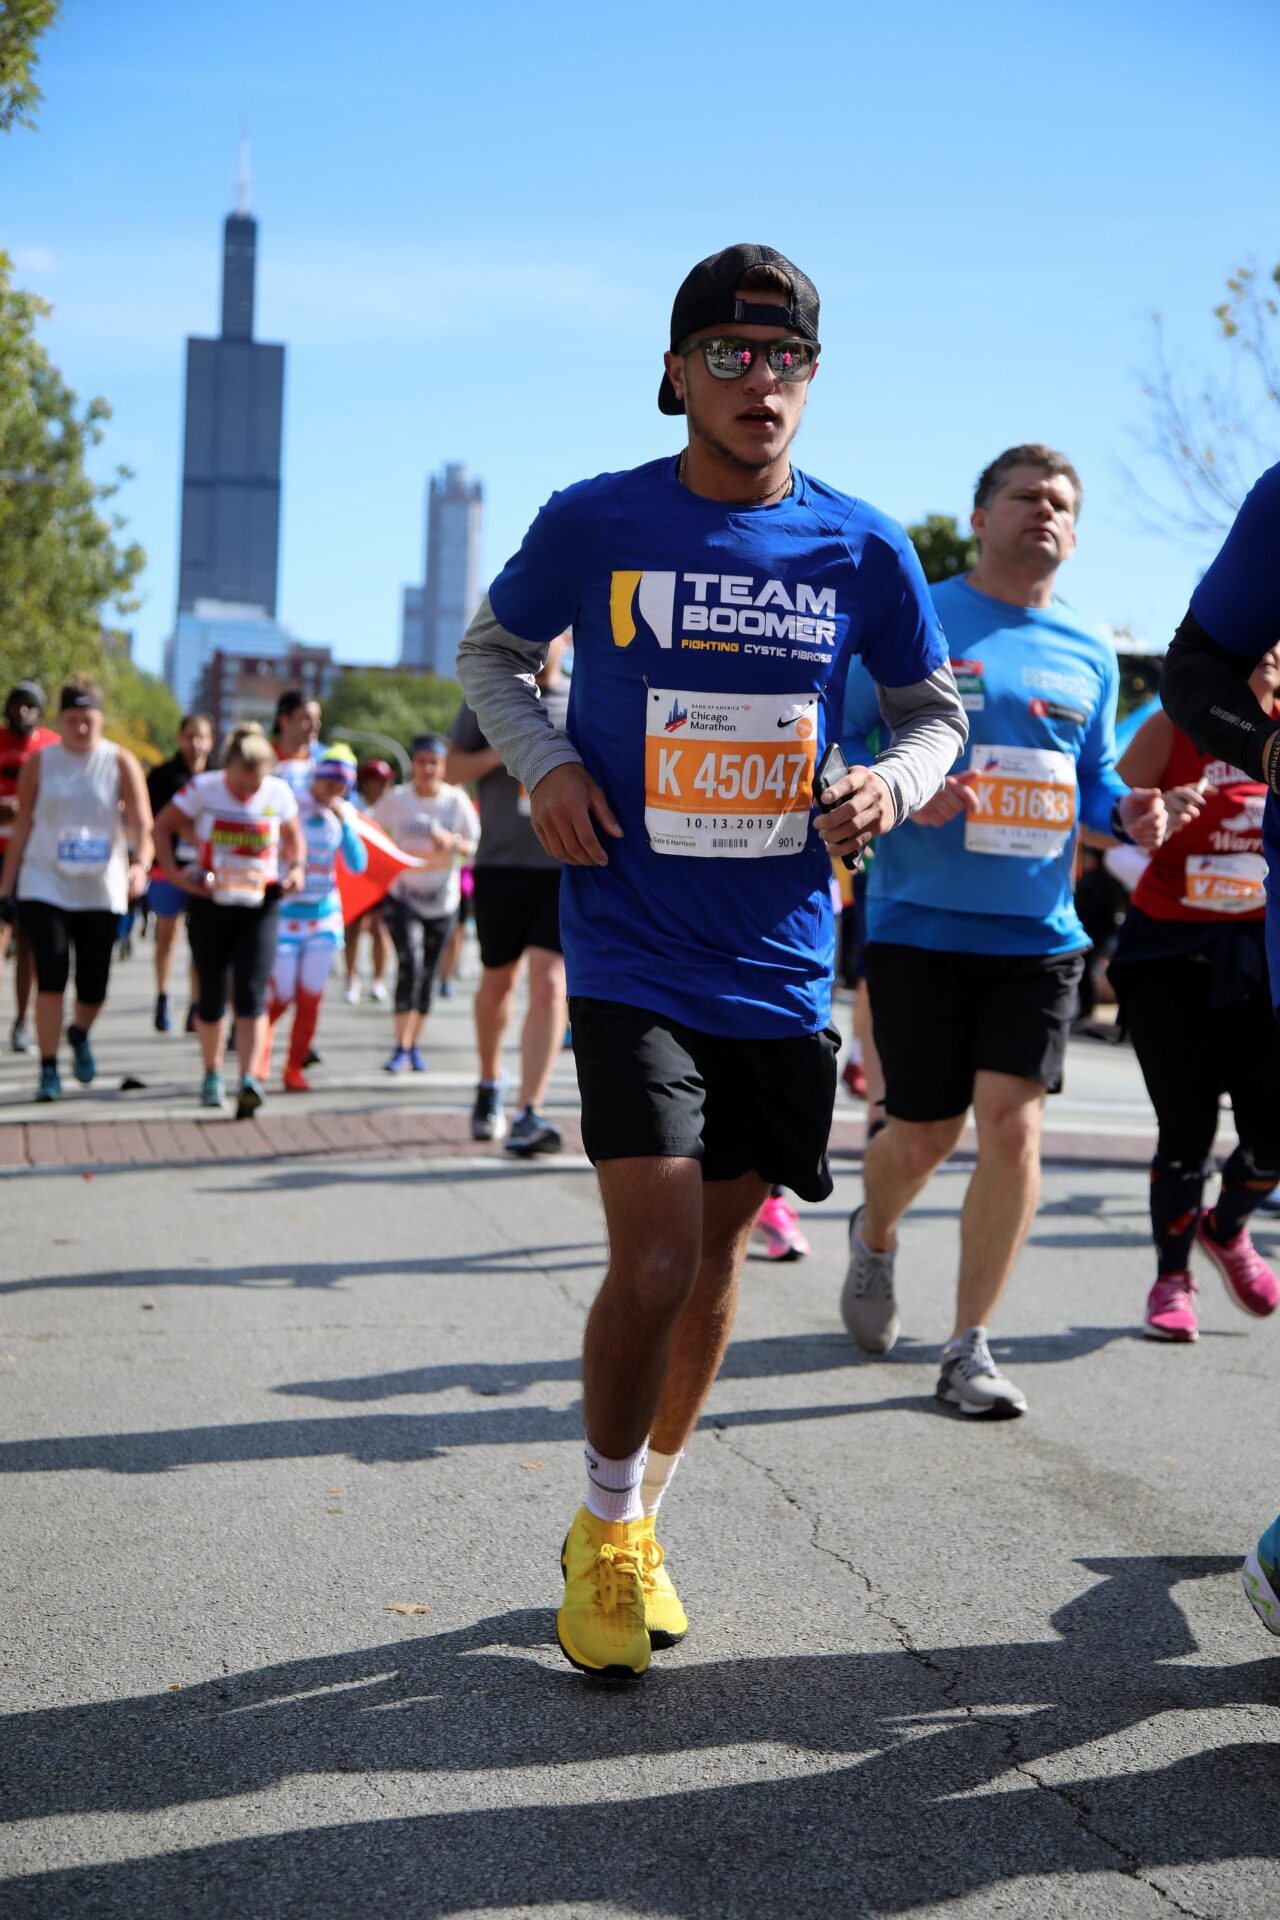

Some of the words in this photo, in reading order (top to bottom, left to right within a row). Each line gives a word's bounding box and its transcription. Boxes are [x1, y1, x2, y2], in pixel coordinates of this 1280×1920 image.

[683, 572, 837, 617] TEAM
[682, 605, 836, 646] BOOMER
[681, 638, 740, 653] FIGHTING
[744, 644, 787, 657] CYSTIC
[791, 649, 832, 663] FIBROSIS
[691, 711, 728, 722] Chicago
[690, 721, 737, 732] Marathon
[658, 749, 684, 797] K
[693, 752, 807, 800] 45047
[977, 783, 996, 815] K
[1000, 785, 1069, 821] 51683
[685, 818, 774, 830] 10.13.2019
[653, 836, 666, 845] Gate
[671, 839, 697, 847] Harrison
[778, 837, 794, 848] 901
